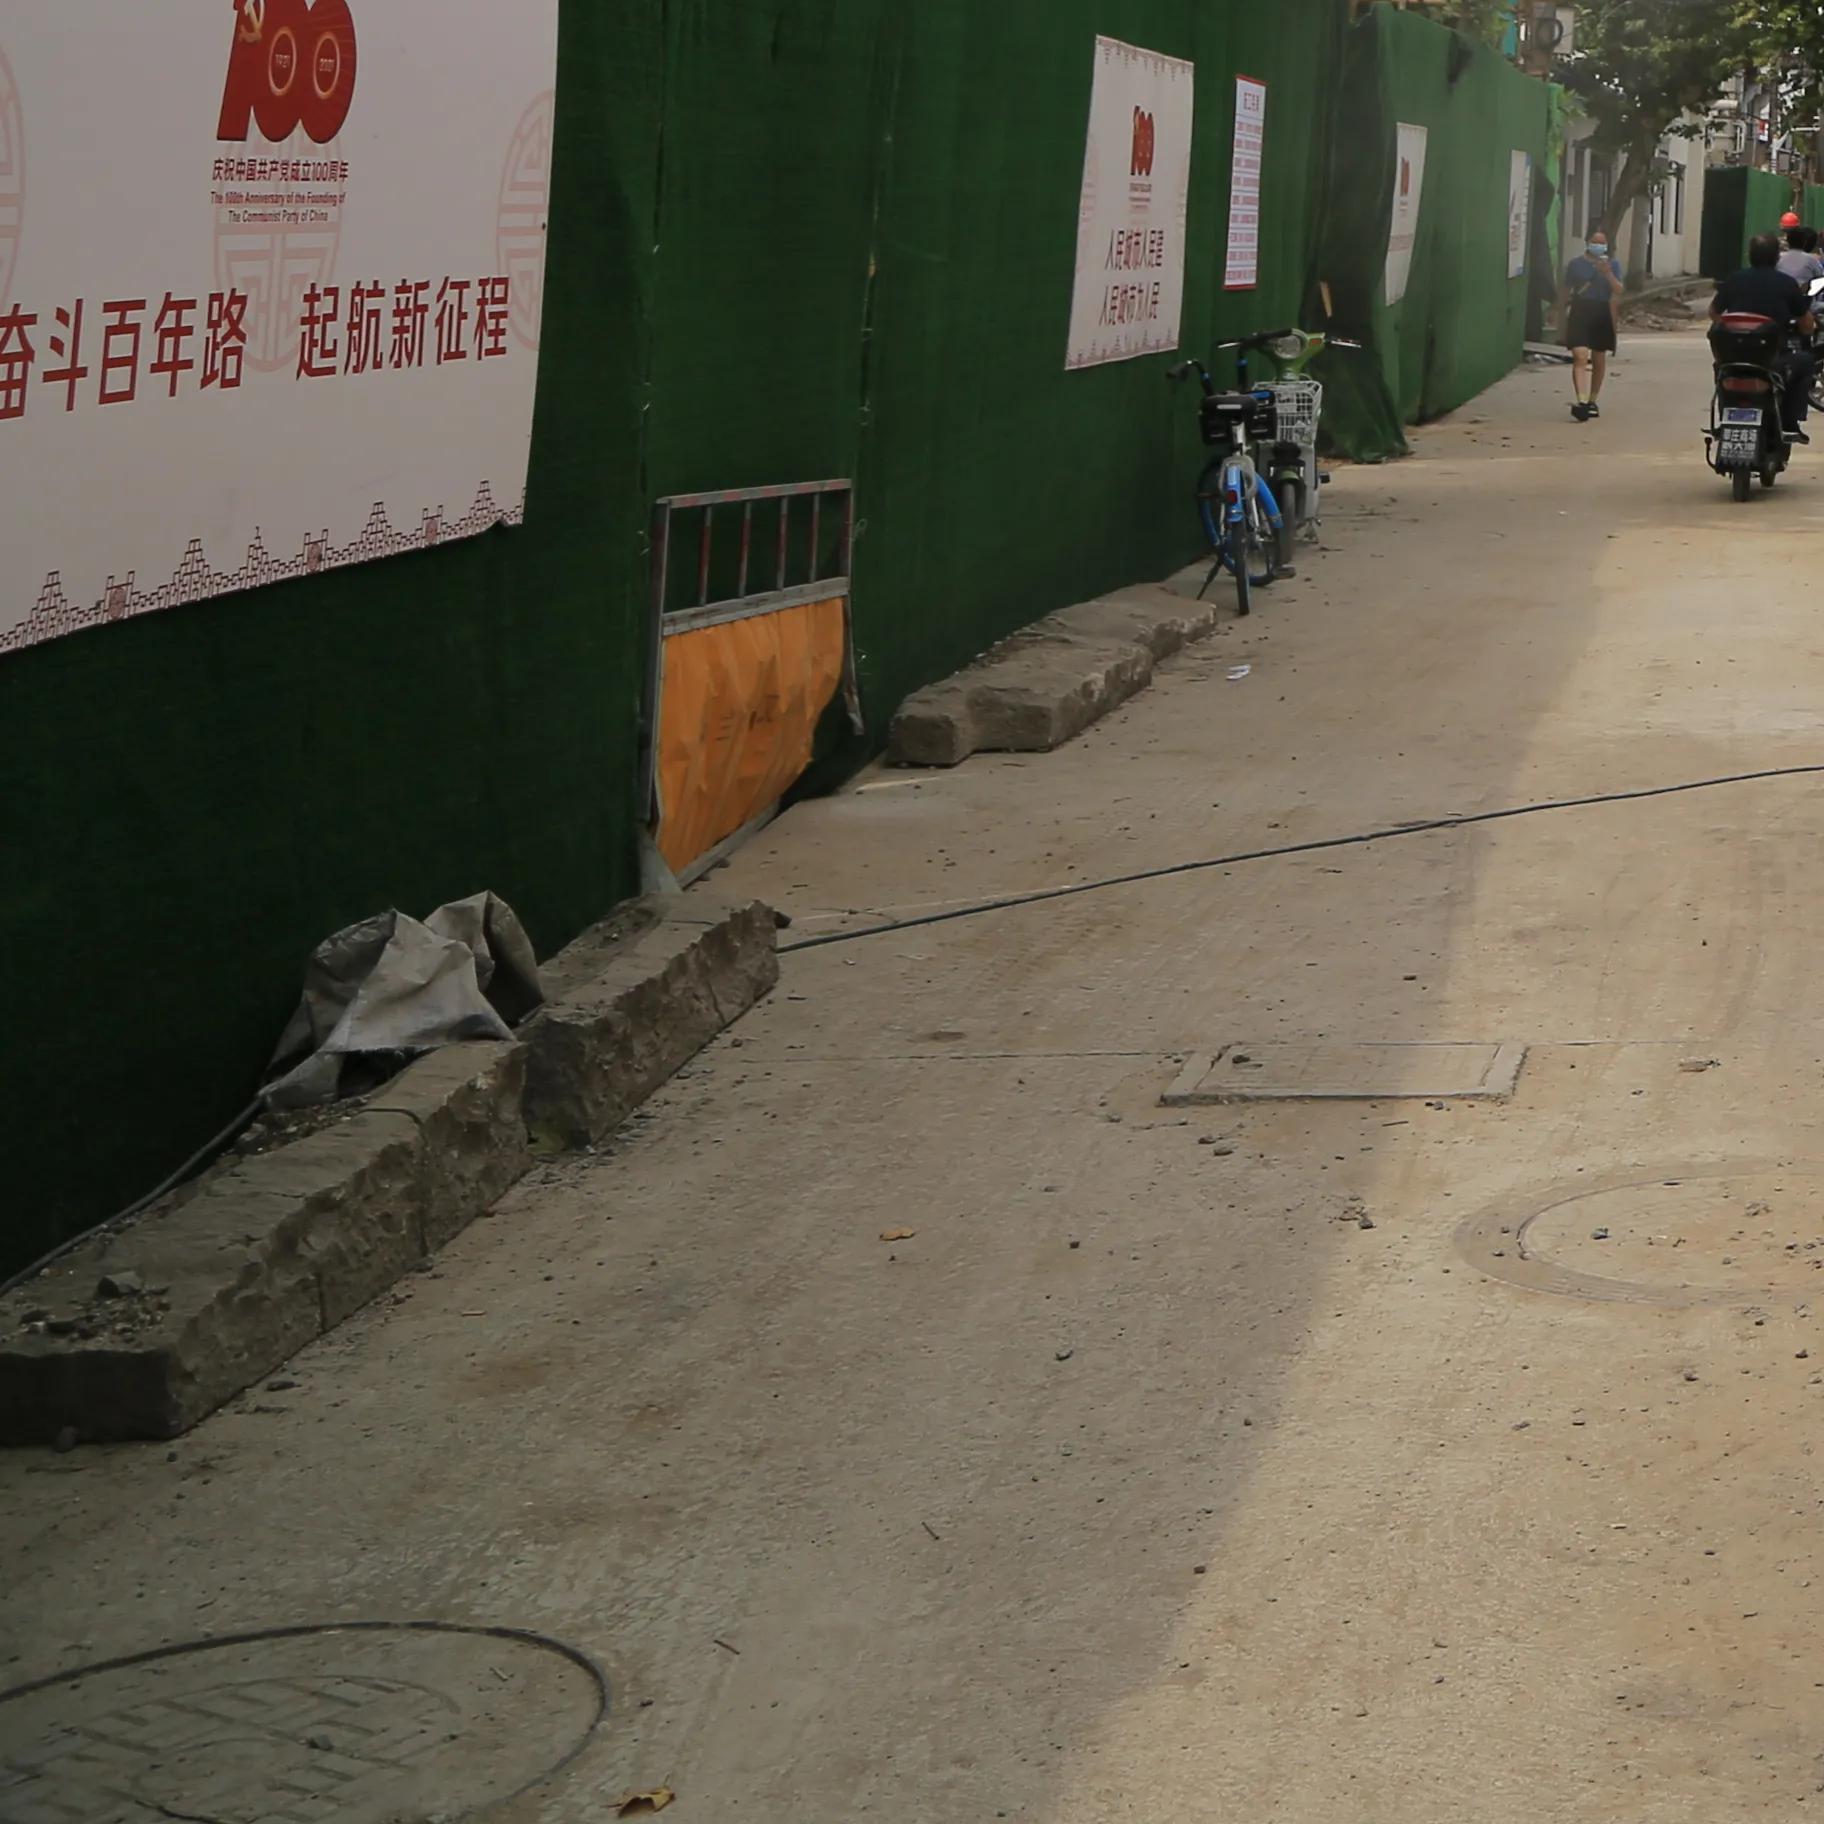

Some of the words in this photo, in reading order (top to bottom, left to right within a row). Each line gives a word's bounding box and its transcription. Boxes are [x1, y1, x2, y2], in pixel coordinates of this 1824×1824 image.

[210, 191, 223, 204] The
[245, 192, 285, 206] Anniversary
[286, 191, 294, 204] of
[307, 191, 337, 207] Founding
[229, 209, 241, 222] The
[283, 209, 299, 224] Party
[301, 209, 308, 222] of
[309, 209, 328, 222] China
[0, 288, 249, 421] 奋斗百年路
[296, 276, 510, 381] 起航新征程
